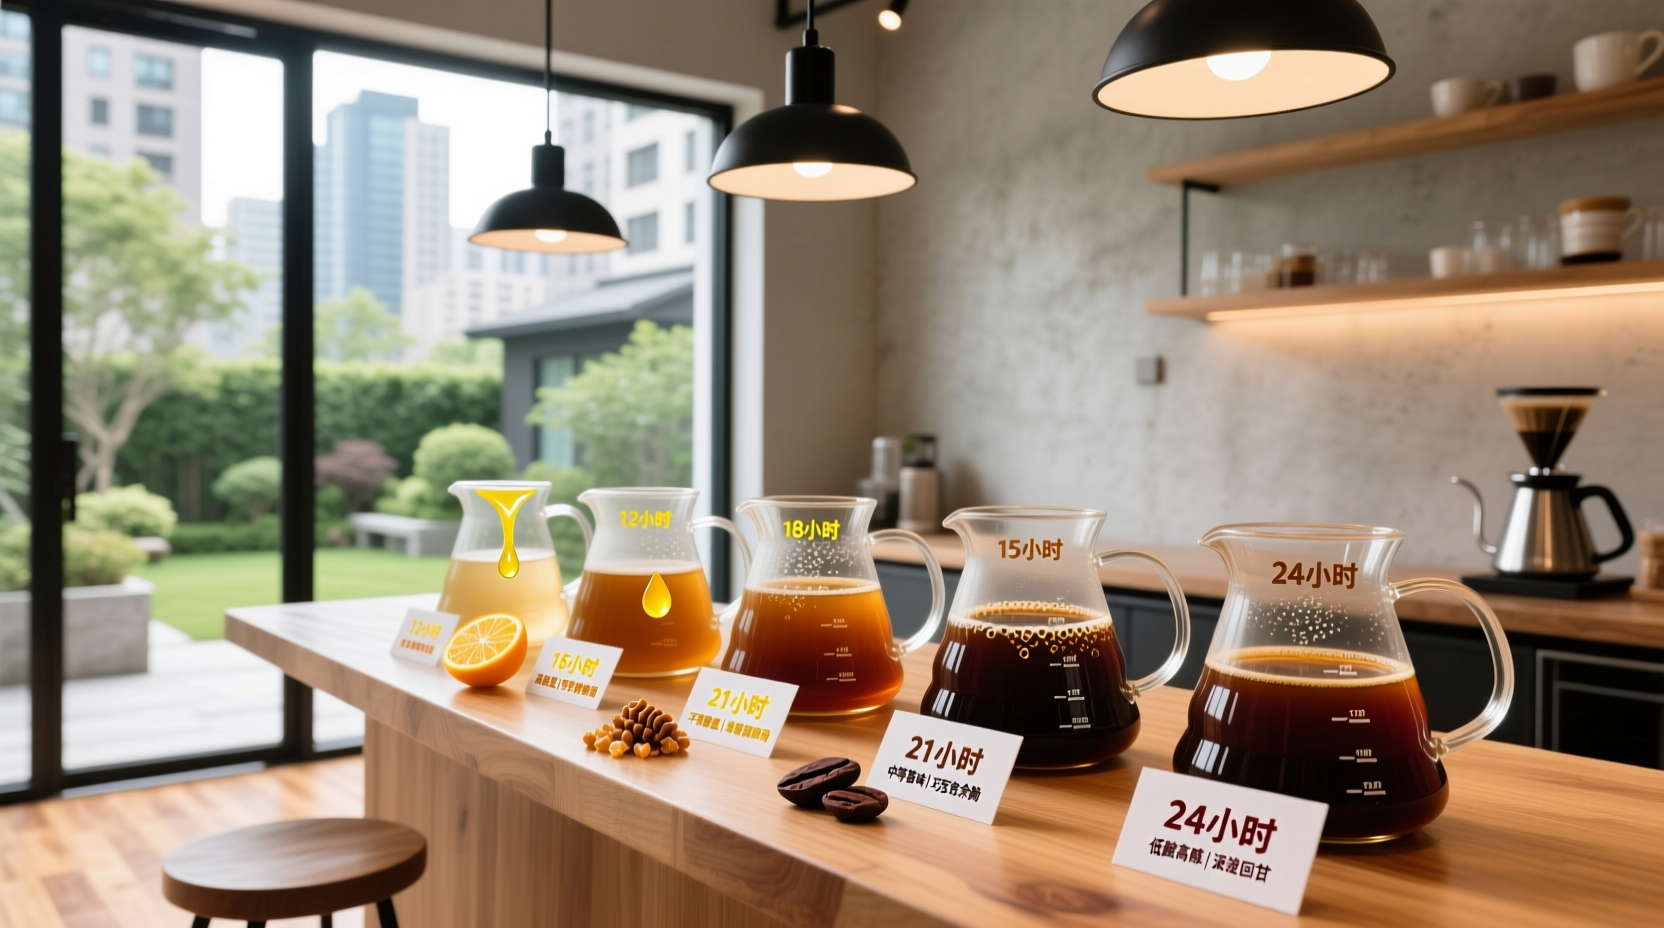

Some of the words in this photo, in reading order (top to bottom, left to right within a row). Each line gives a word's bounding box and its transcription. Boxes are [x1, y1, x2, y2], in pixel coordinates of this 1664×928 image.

[783, 519, 840, 541] 18小时
[997, 538, 1064, 561] 15小时
[1271, 561, 1358, 589] 24小时
[707, 687, 770, 720] 21小时
[905, 735, 984, 776] 21小时
[1163, 799, 1278, 854] 24小时
